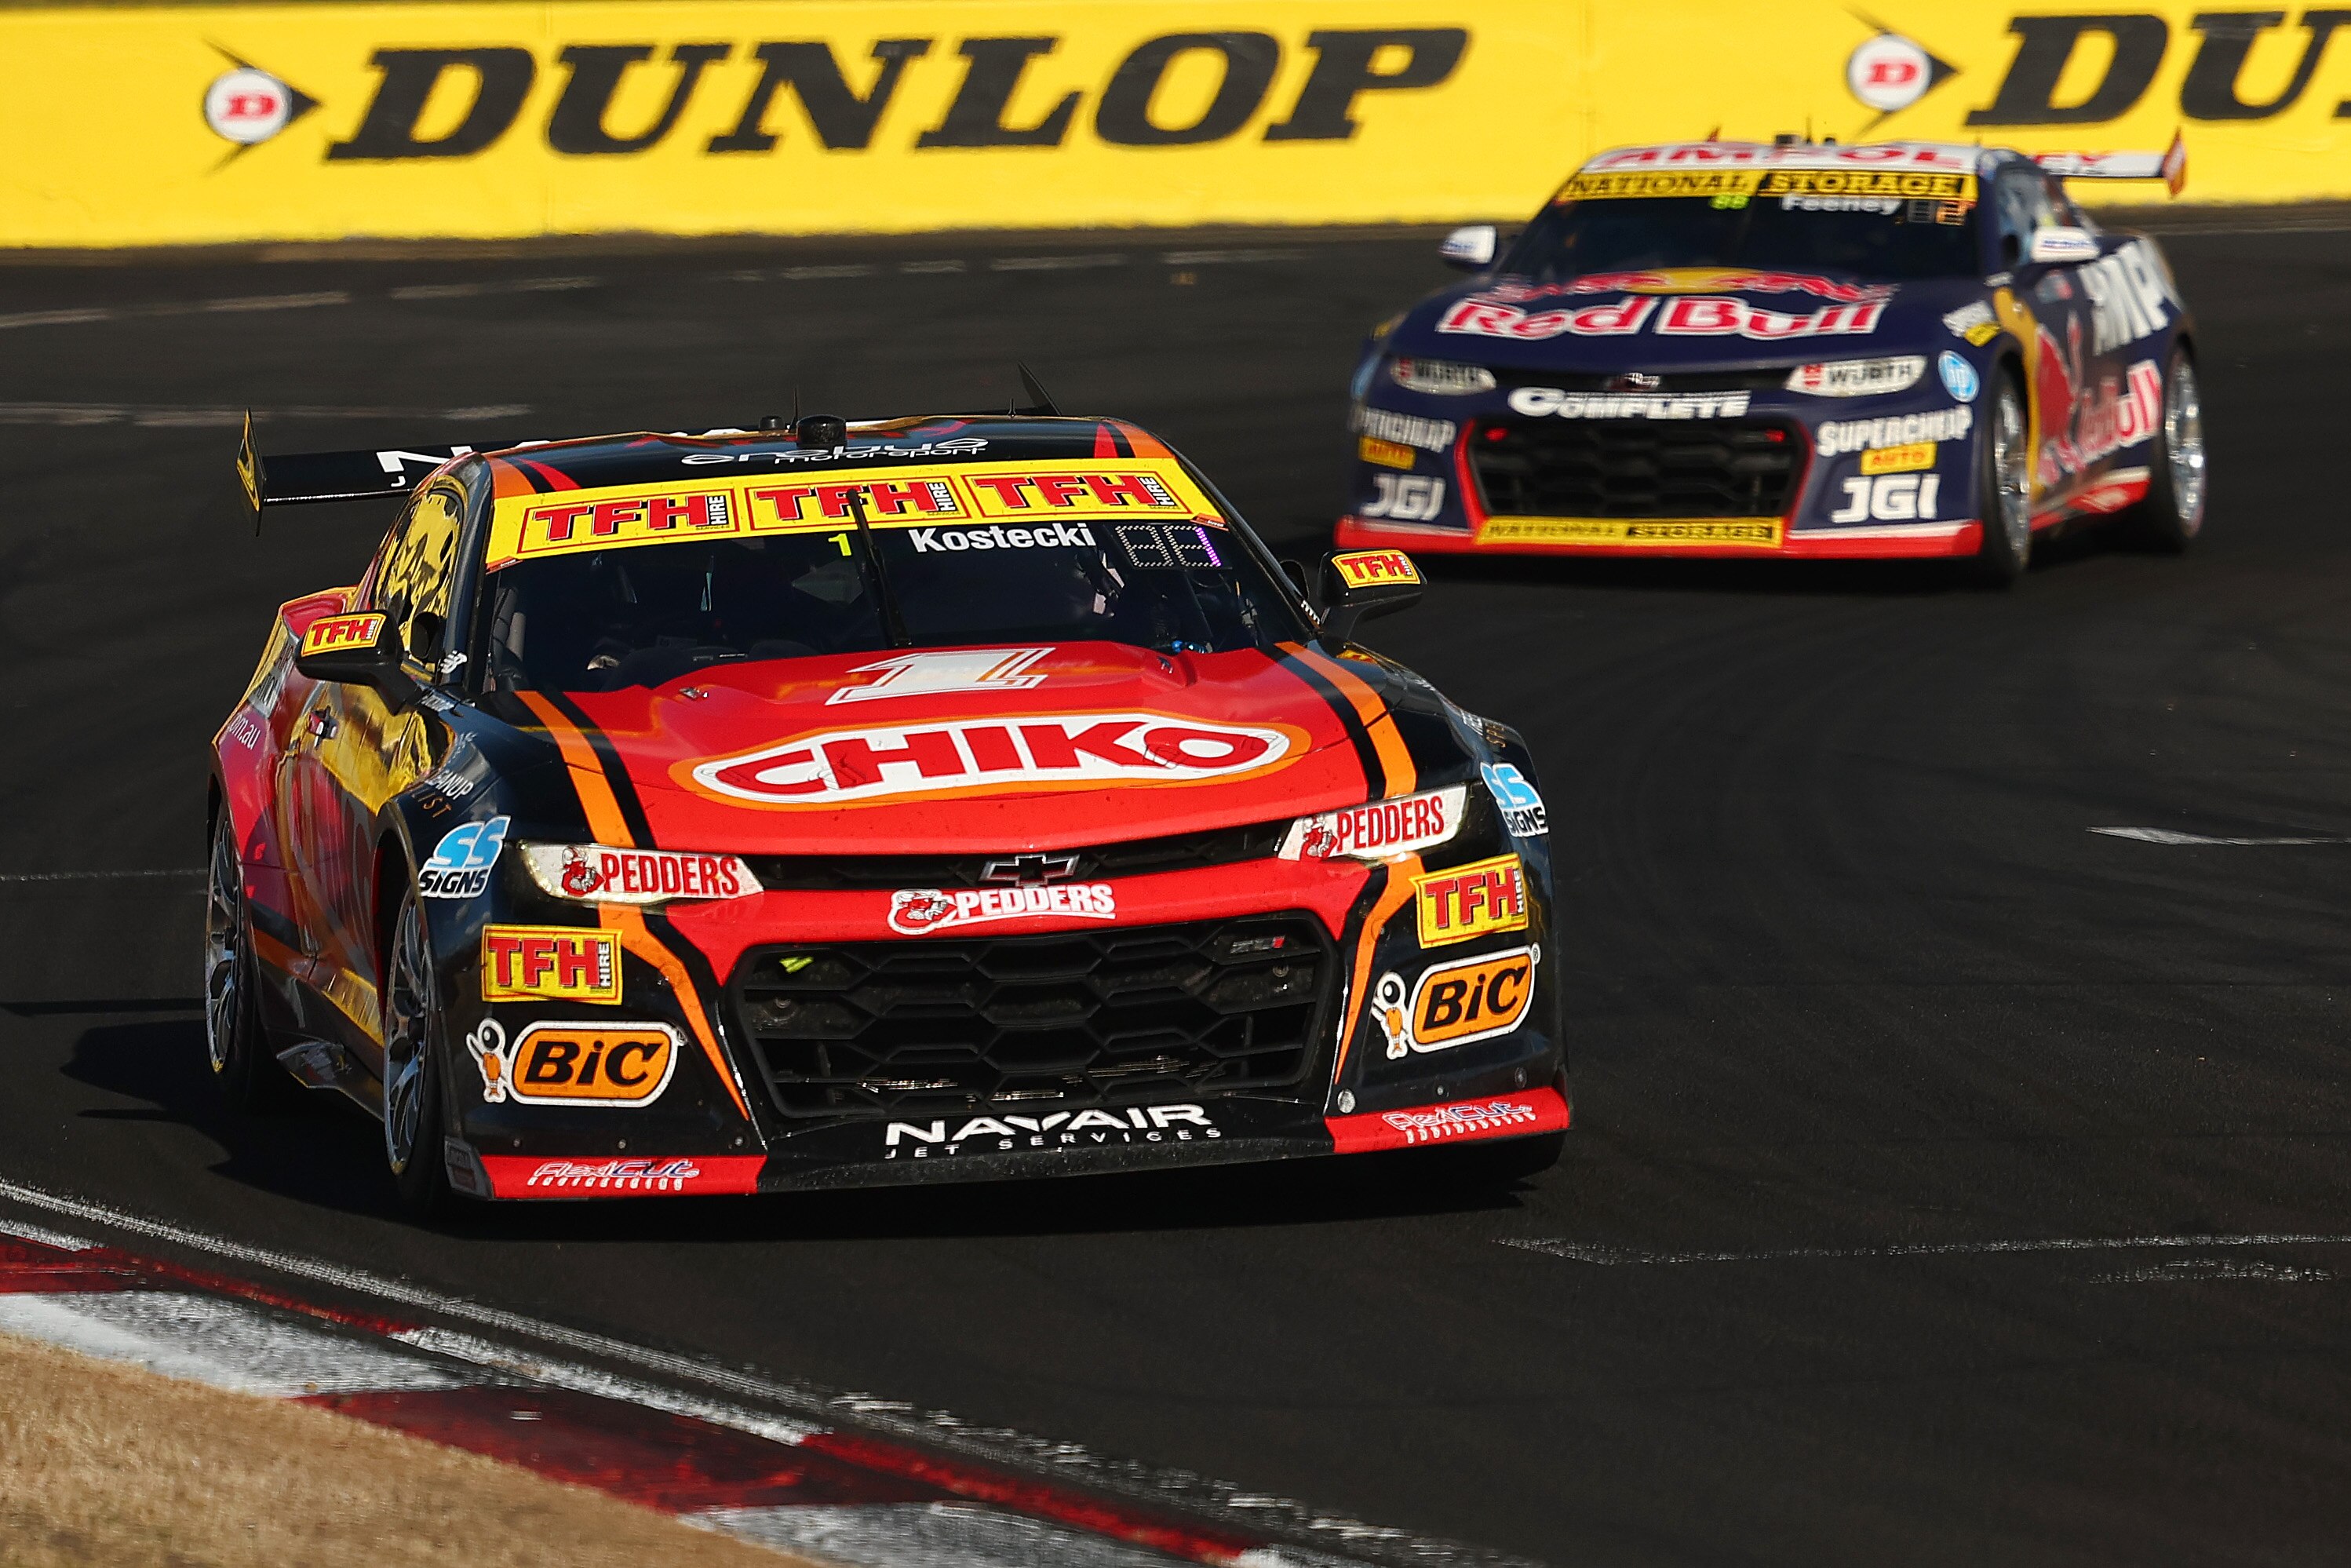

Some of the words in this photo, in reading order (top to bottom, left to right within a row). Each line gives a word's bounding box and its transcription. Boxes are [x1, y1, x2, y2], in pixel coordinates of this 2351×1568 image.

[1966, 10, 2351, 126] DU
[322, 28, 1468, 162] DUNLOP
[1769, 171, 1960, 195] STORAGE
[1781, 193, 1902, 215] Feeney
[1435, 297, 1660, 339] Red
[1653, 295, 1891, 339] Bull
[755, 481, 939, 520] TFH
[928, 482, 957, 511] HIRE
[974, 474, 1161, 508] TFH
[1139, 476, 1176, 505] HIRE
[534, 494, 711, 542] TFH
[709, 494, 728, 525] HIRE
[828, 533, 852, 556] 1
[909, 523, 1096, 552] Kostecki
[1341, 553, 1406, 579] TFH
[312, 618, 373, 647] TFH
[825, 647, 1056, 706] 1
[714, 720, 1271, 794] CHIKO
[1337, 796, 1445, 852] PEDDERS
[1505, 806, 1546, 836] SIGNS
[419, 869, 489, 896] SIGNS
[601, 854, 739, 895] PEDDERS
[1514, 869, 1525, 914] HIRE
[958, 884, 1115, 918] PEDDERS
[1424, 867, 1519, 928] TFH
[487, 938, 601, 987] TFH
[599, 943, 611, 987] HIRE
[885, 1103, 1212, 1147] NAVAIR
[884, 1145, 960, 1160] JET
[998, 1127, 1221, 1150] SERVICES
